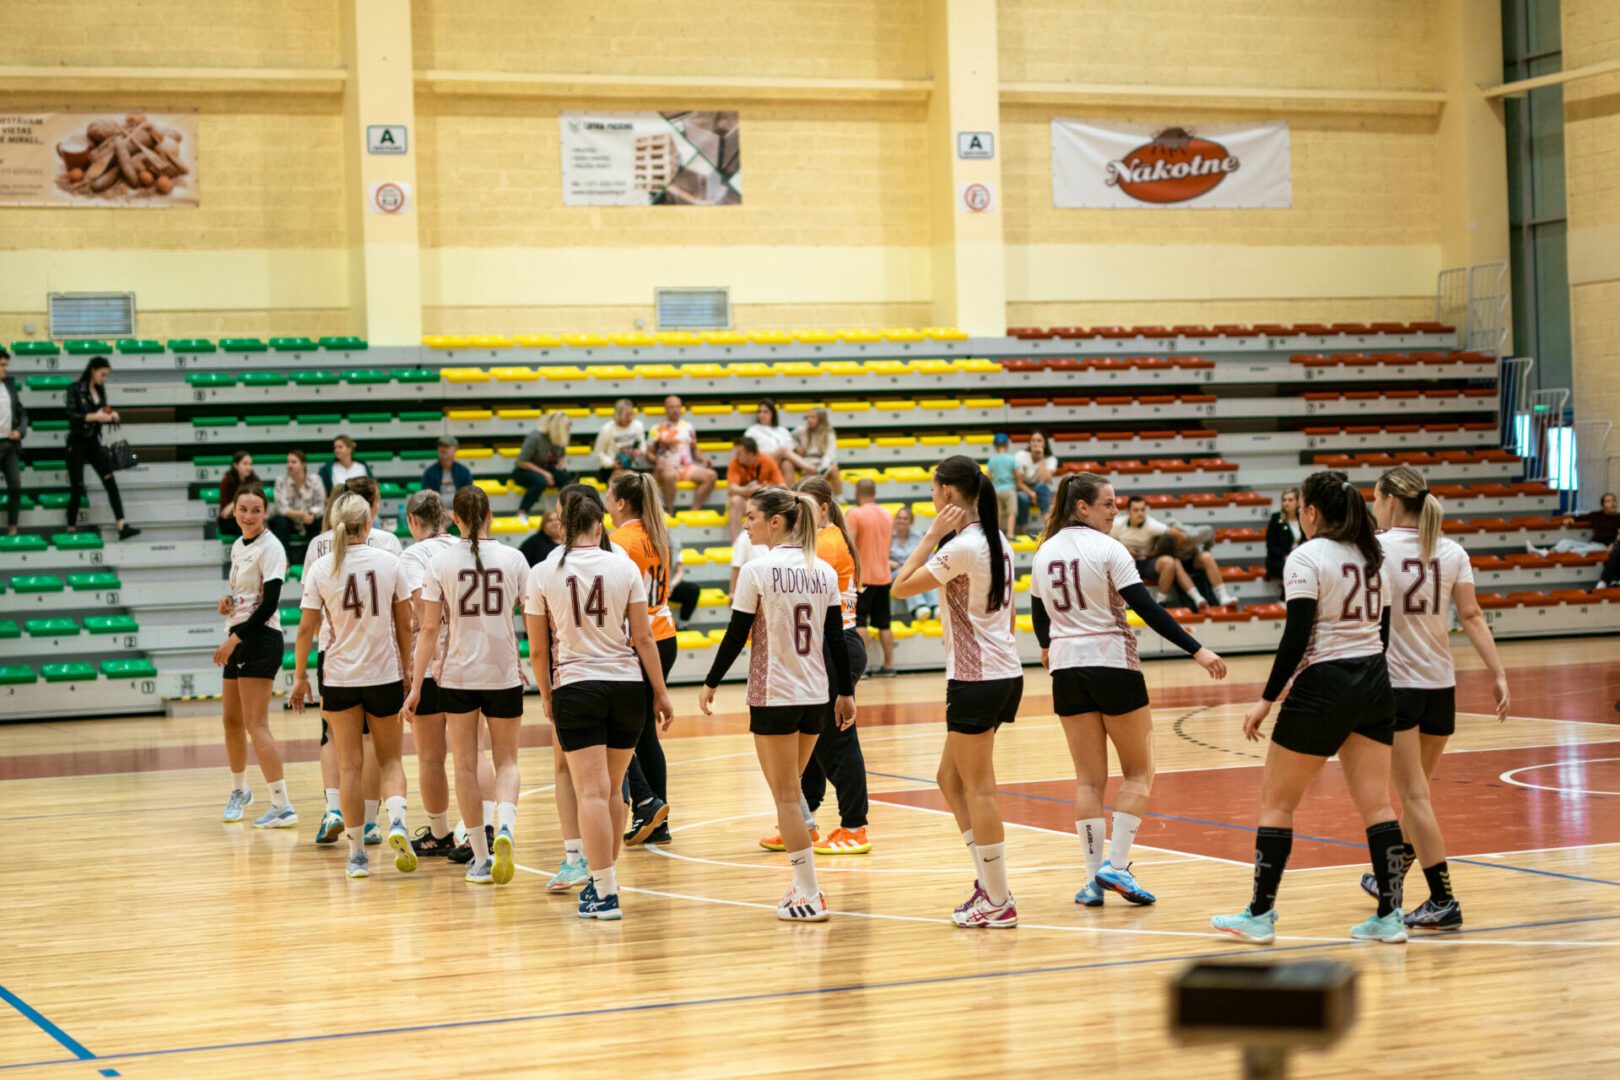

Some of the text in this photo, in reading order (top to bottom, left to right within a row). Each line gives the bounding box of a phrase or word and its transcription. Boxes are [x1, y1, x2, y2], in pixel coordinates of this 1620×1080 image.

[380, 128, 395, 144] A
[969, 134, 983, 149] A
[342, 570, 379, 619] 41
[458, 568, 503, 617] 26
[566, 575, 607, 627] 14
[1047, 558, 1087, 612] 31
[1341, 563, 1381, 621] 28
[1402, 558, 1440, 615] 21
[793, 603, 812, 657] 6
